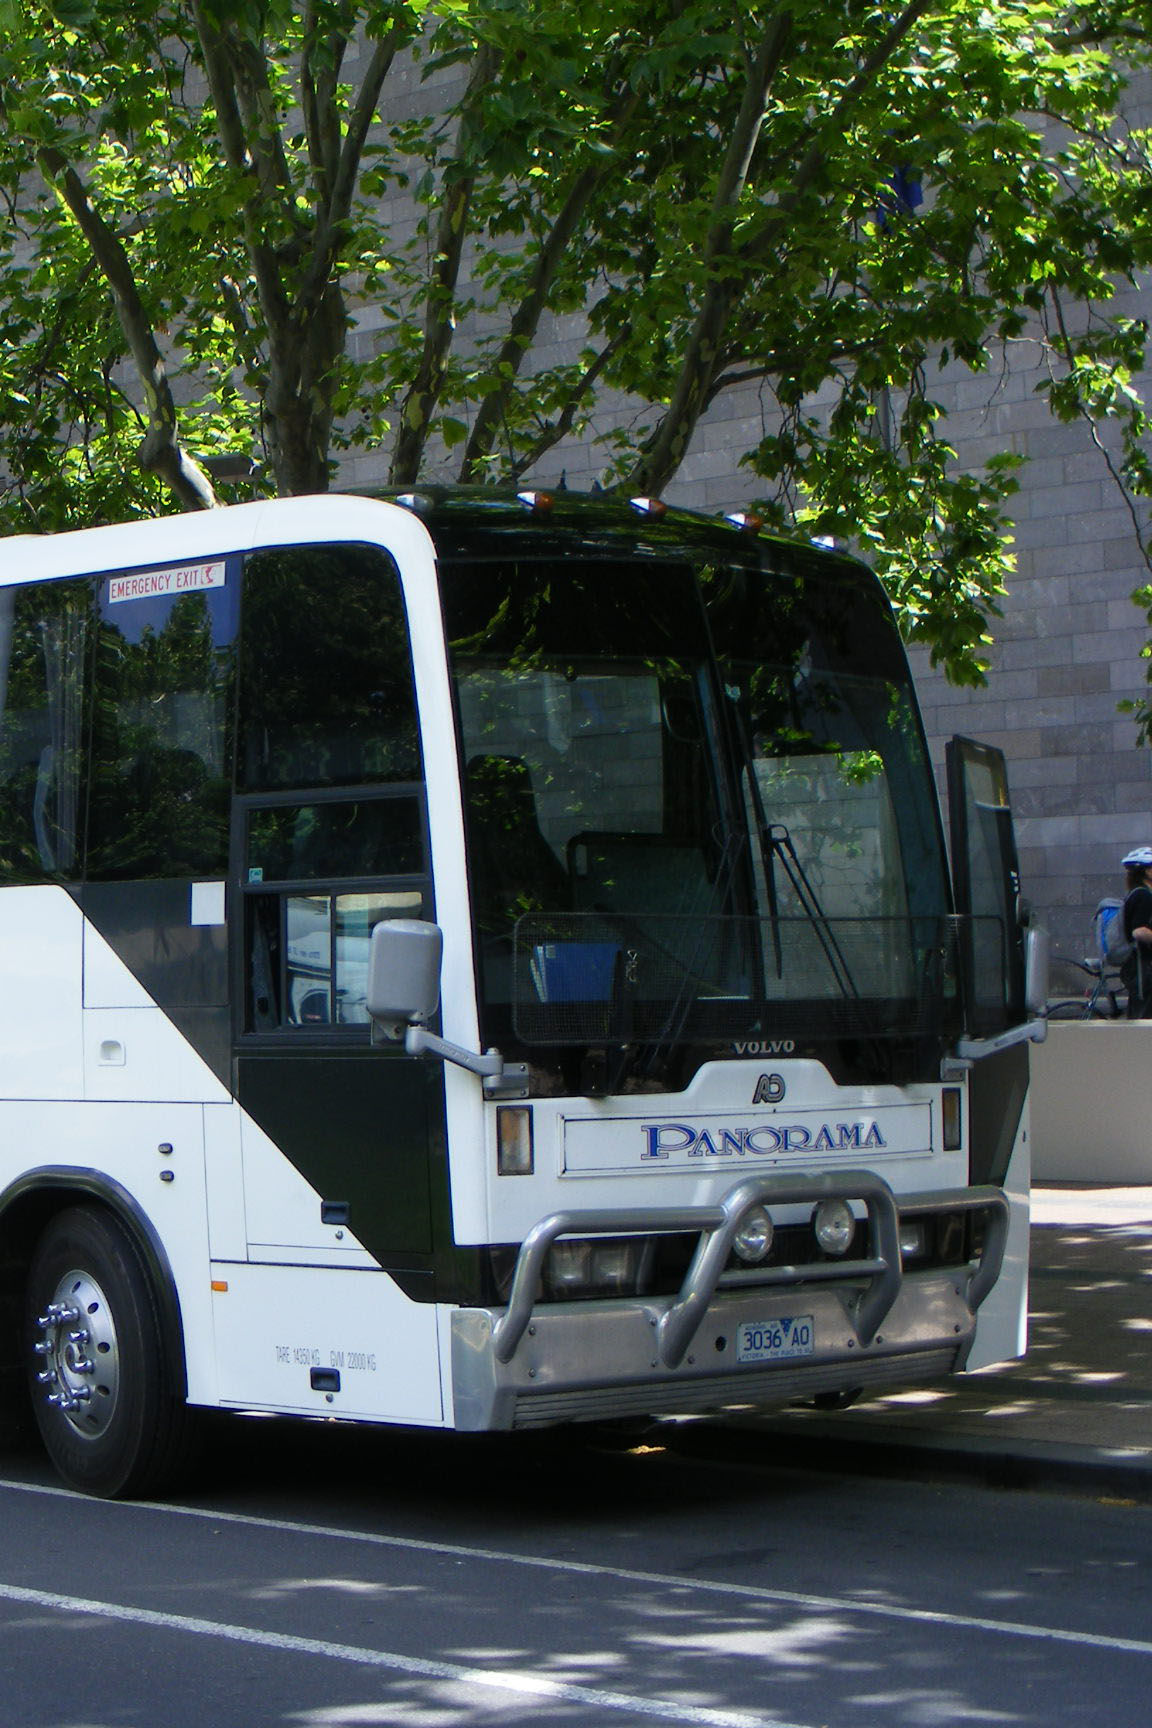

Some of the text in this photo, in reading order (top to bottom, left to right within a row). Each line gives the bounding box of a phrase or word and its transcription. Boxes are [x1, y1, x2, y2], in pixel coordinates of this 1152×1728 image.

[111, 570, 199, 599] EMERGENCY EXIT
[734, 1040, 795, 1055] VOLVO
[640, 1121, 887, 1160] PANORAMA
[743, 1328, 782, 1351] 3036
[275, 1345, 290, 1364] TARE
[330, 1350, 345, 1368] GVM
